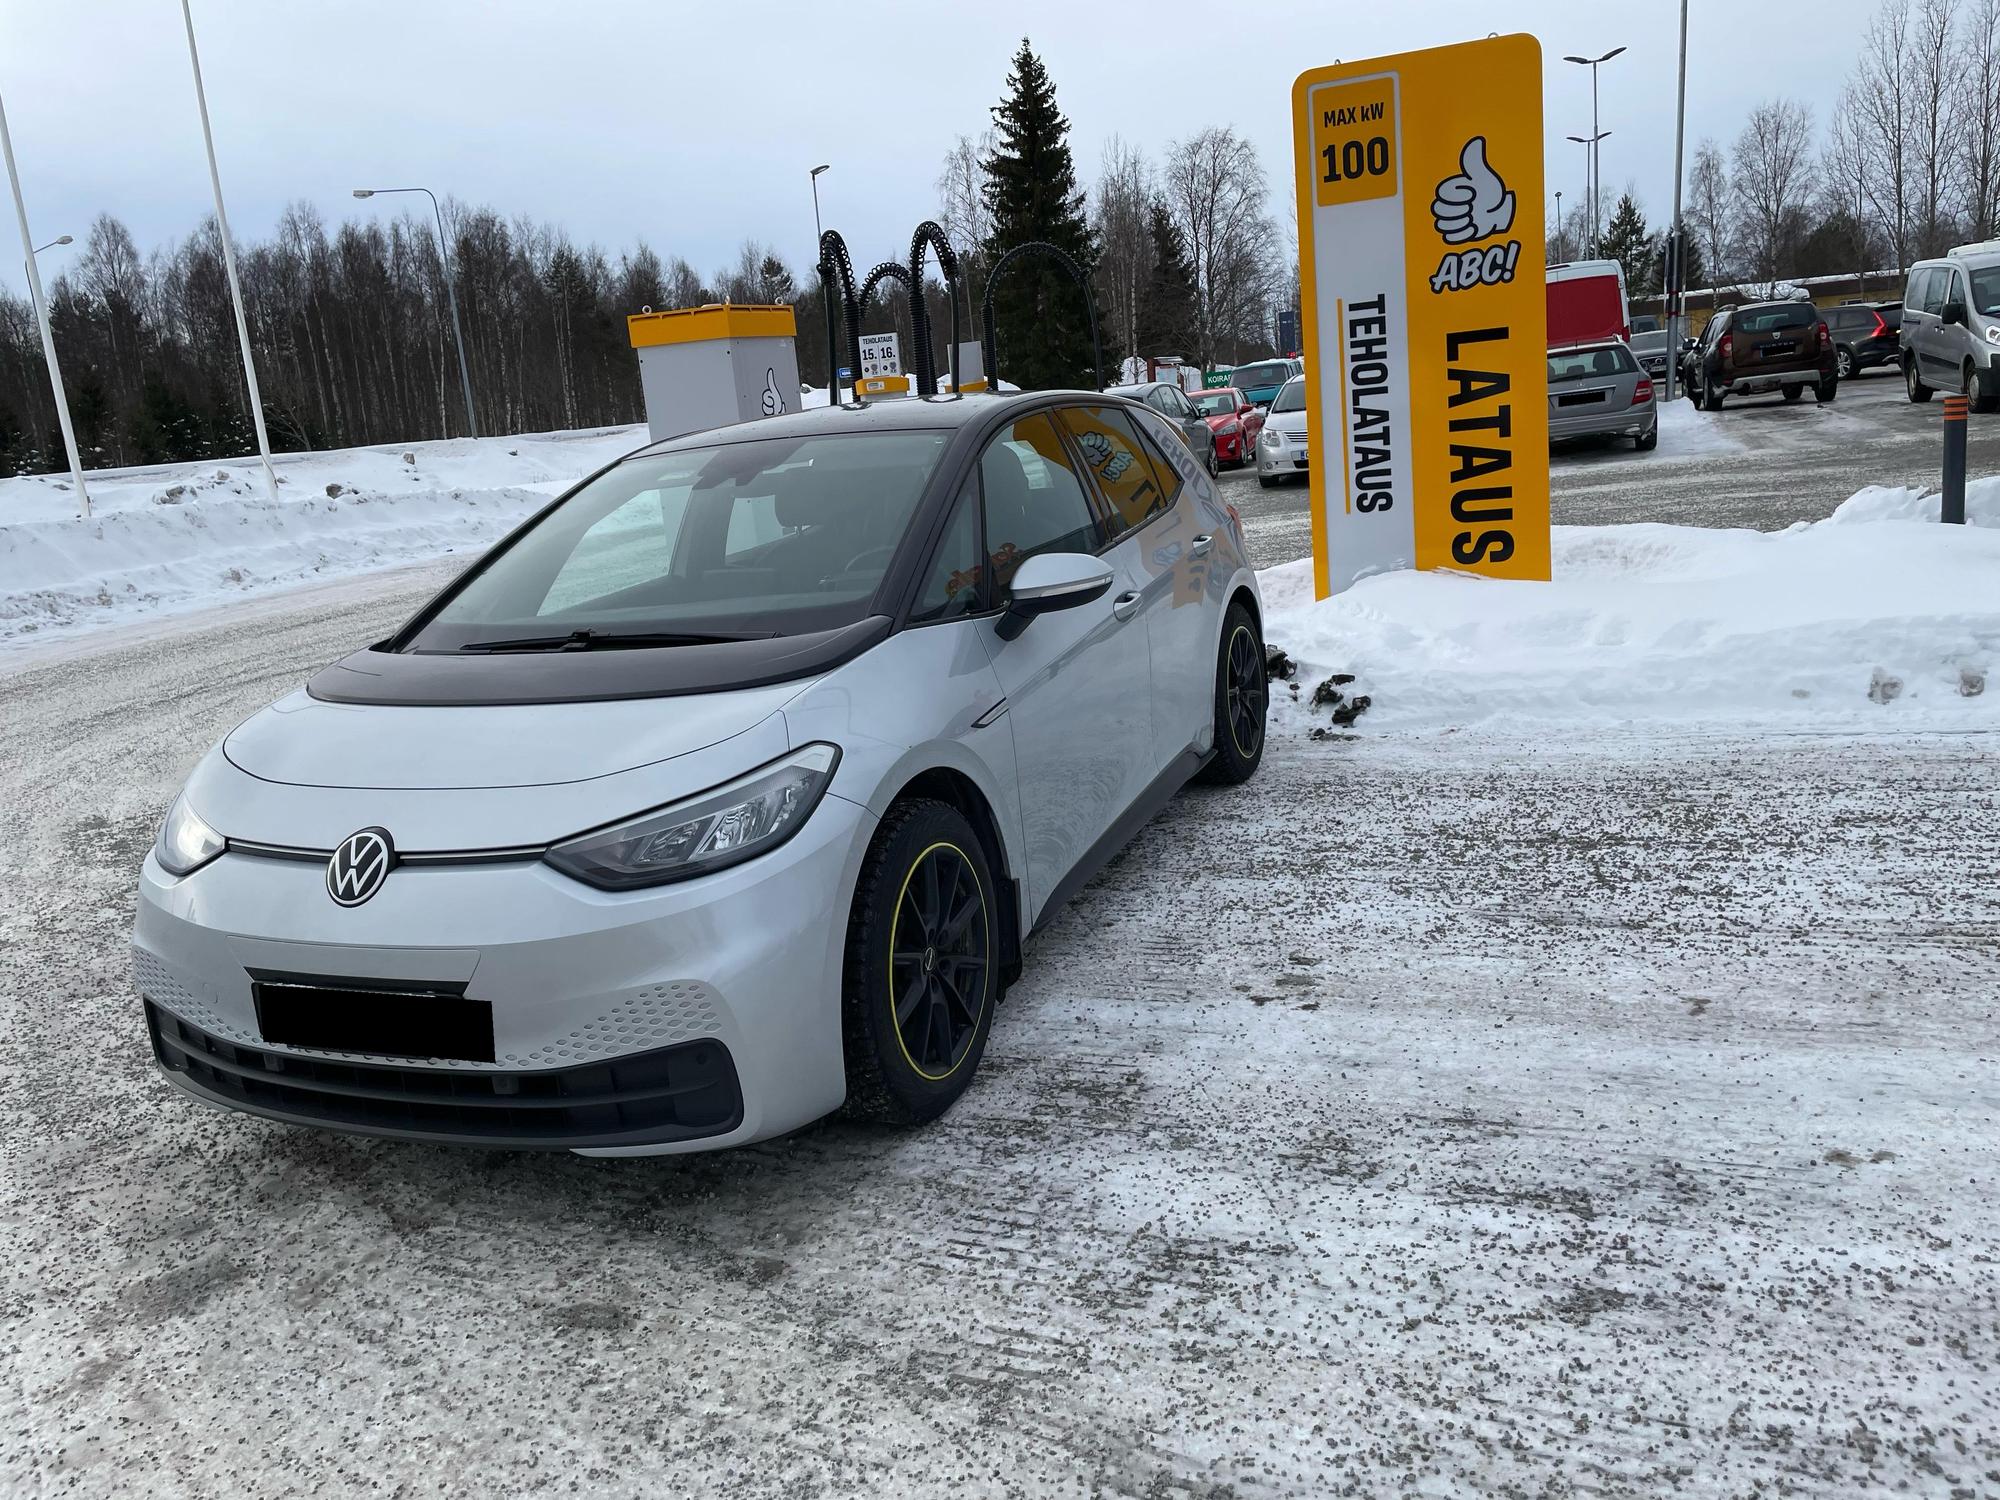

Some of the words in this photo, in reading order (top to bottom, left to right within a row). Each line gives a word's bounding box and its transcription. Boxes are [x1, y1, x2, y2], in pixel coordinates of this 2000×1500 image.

[1323, 106, 1358, 128] MAX
[1360, 102, 1385, 122] kW
[1321, 136, 1390, 183] 100
[1430, 241, 1521, 294] ABC!
[862, 348, 877, 360] 15.
[880, 346, 896, 358] 16.
[863, 335, 893, 345] TEHOLATAUS
[1348, 293, 1394, 513] TEHOLATAUS
[1446, 326, 1516, 565] LATAUS
